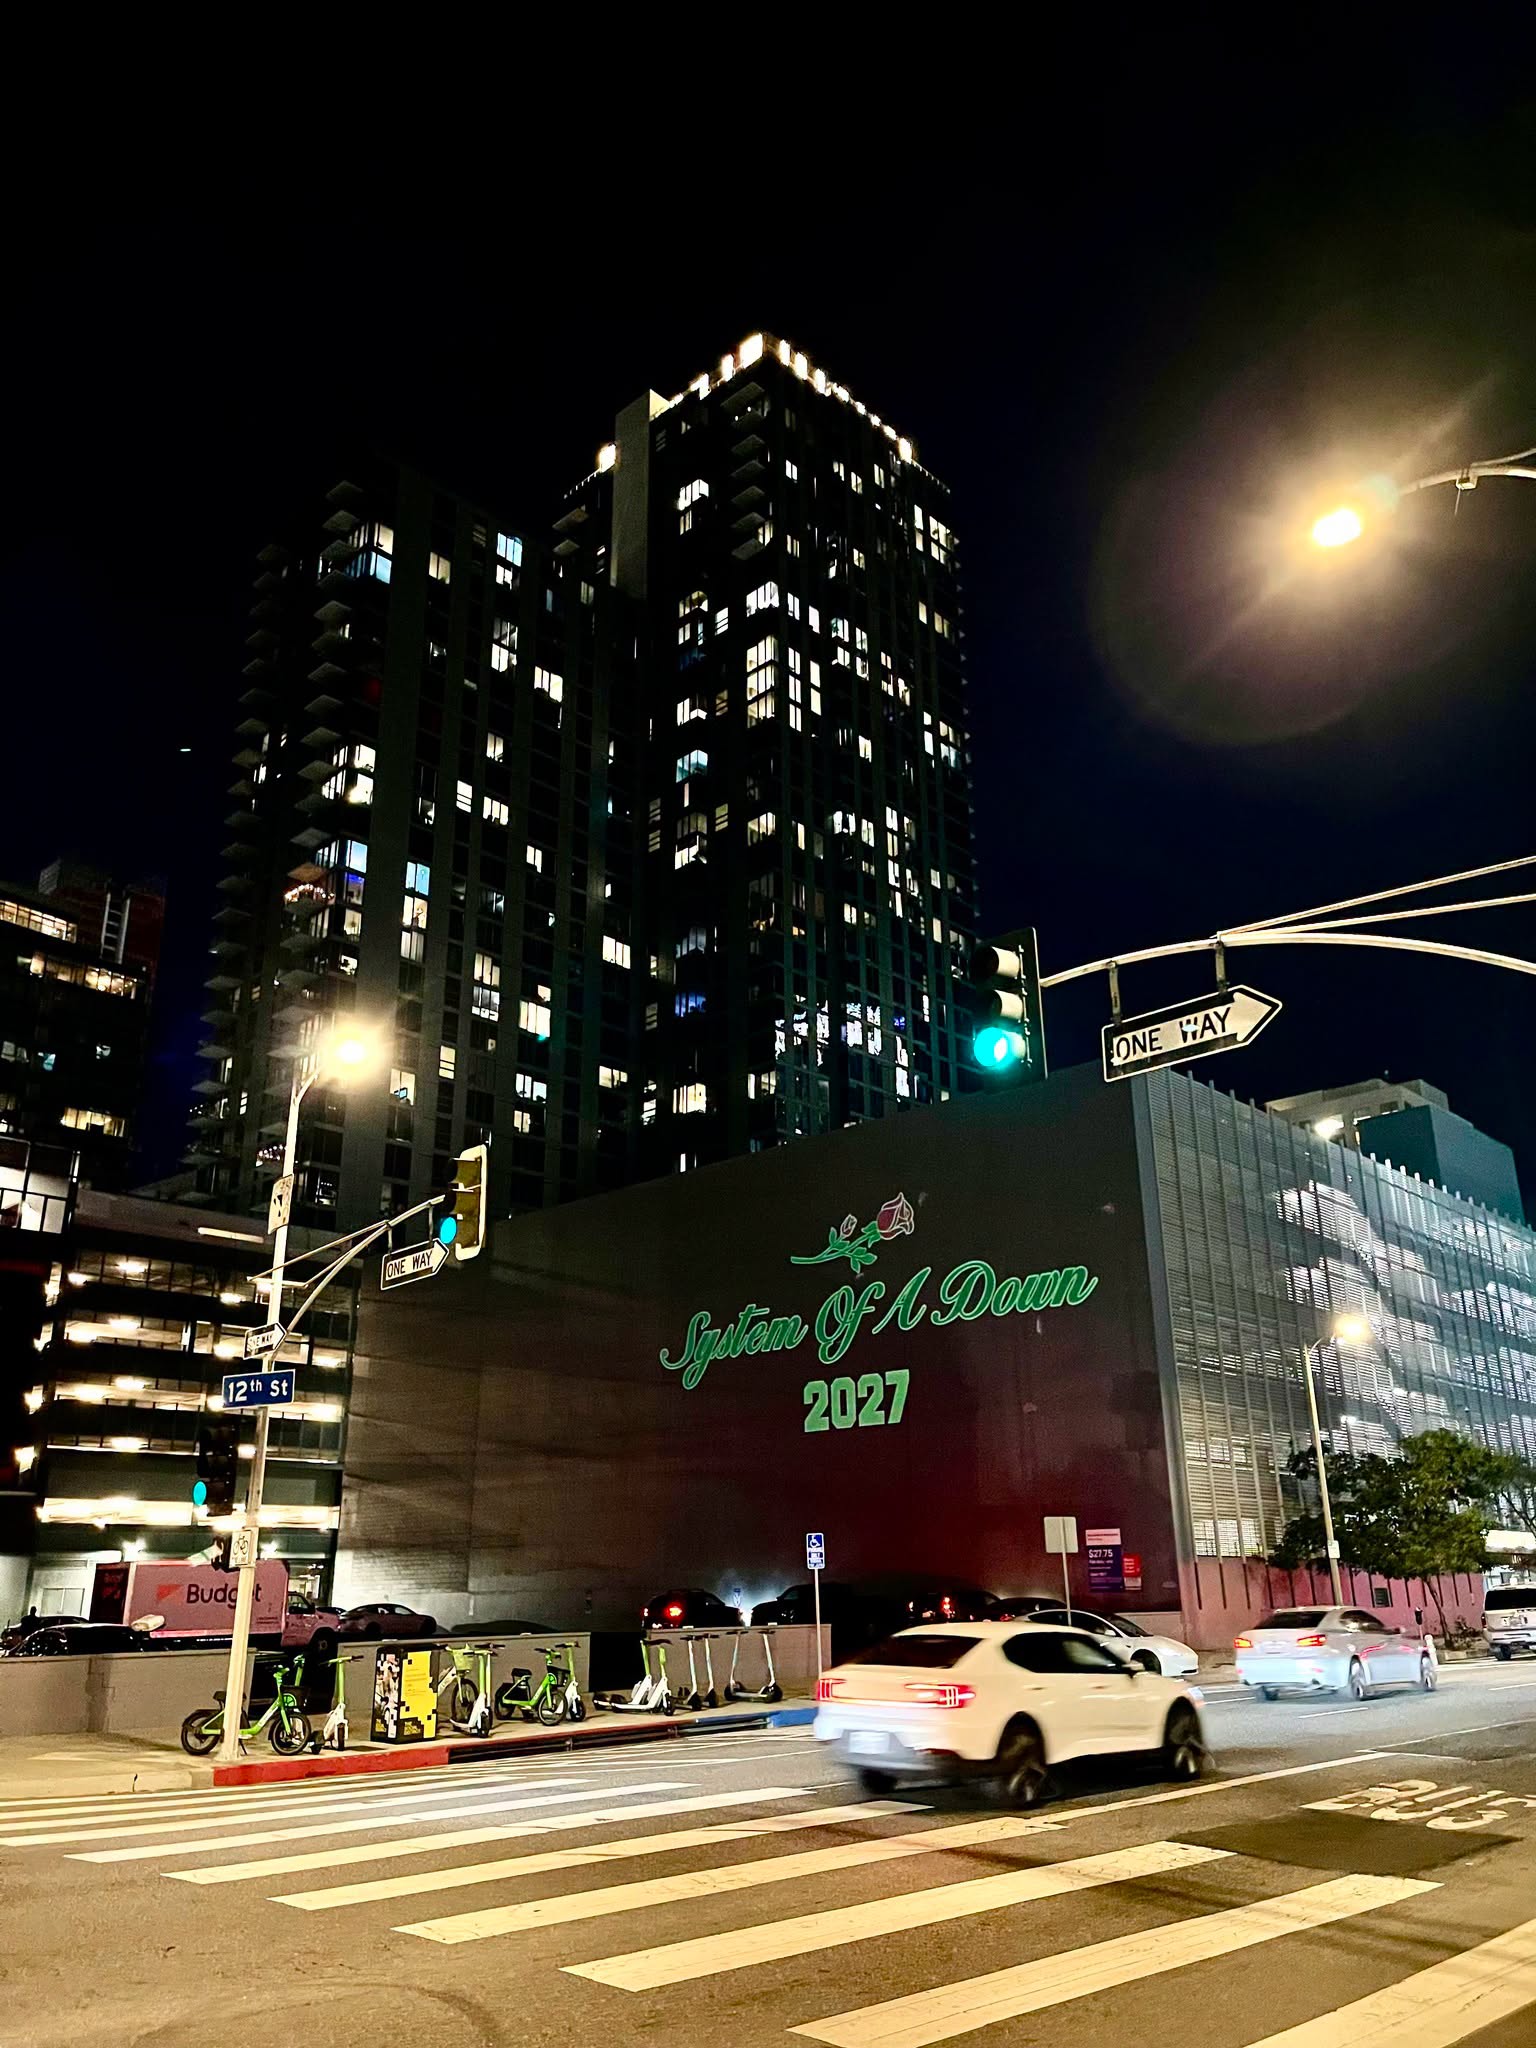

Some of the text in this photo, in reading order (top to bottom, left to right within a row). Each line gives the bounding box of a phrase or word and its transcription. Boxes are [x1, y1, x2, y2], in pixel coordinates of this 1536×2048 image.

[1116, 1006, 1232, 1061] ONE WAY
[387, 1250, 433, 1278] ONE WAY
[659, 1260, 1099, 1391] System Of A Down
[228, 1379, 289, 1403] 12th St
[803, 1368, 911, 1433] 2027
[187, 1583, 262, 1609] Budgt
